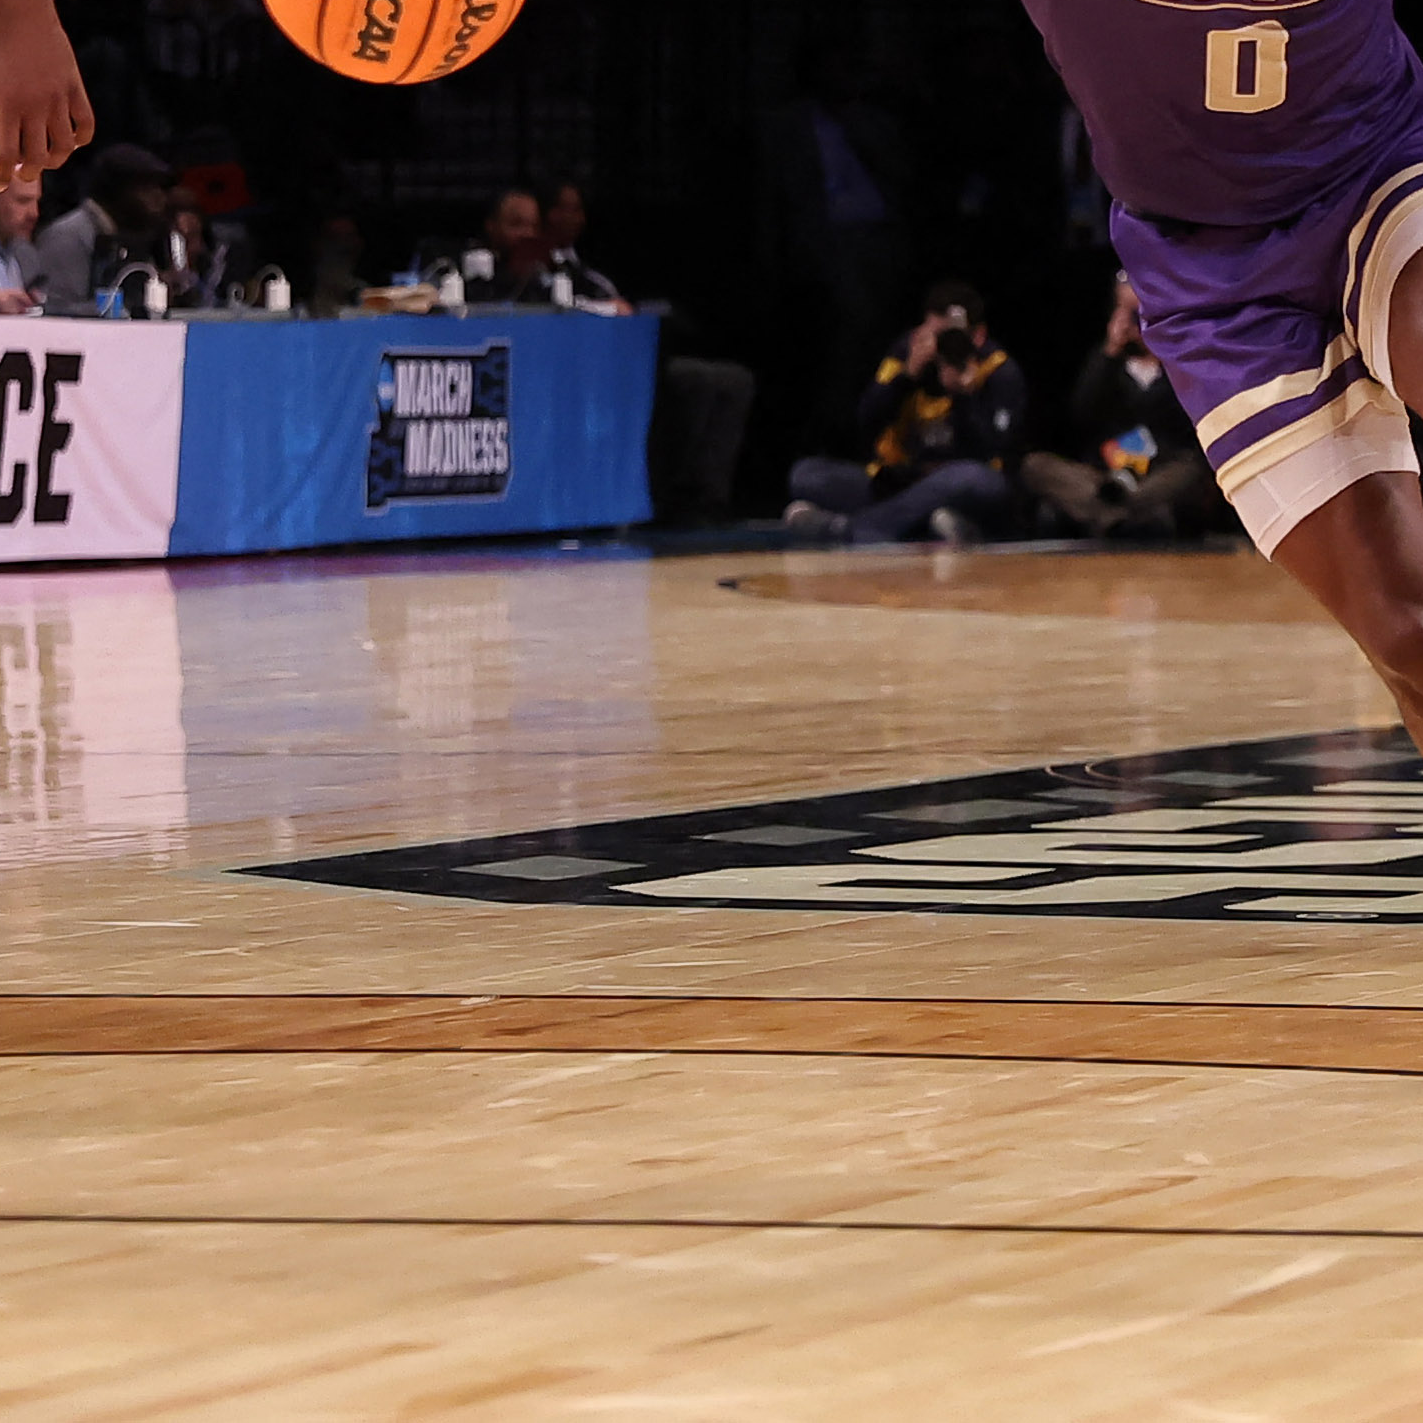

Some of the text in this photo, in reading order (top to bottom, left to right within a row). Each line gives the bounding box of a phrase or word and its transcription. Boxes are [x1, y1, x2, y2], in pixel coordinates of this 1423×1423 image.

[1204, 19, 1290, 114] 0
[394, 358, 473, 419] MARCH
[403, 416, 510, 476] MADNESS
